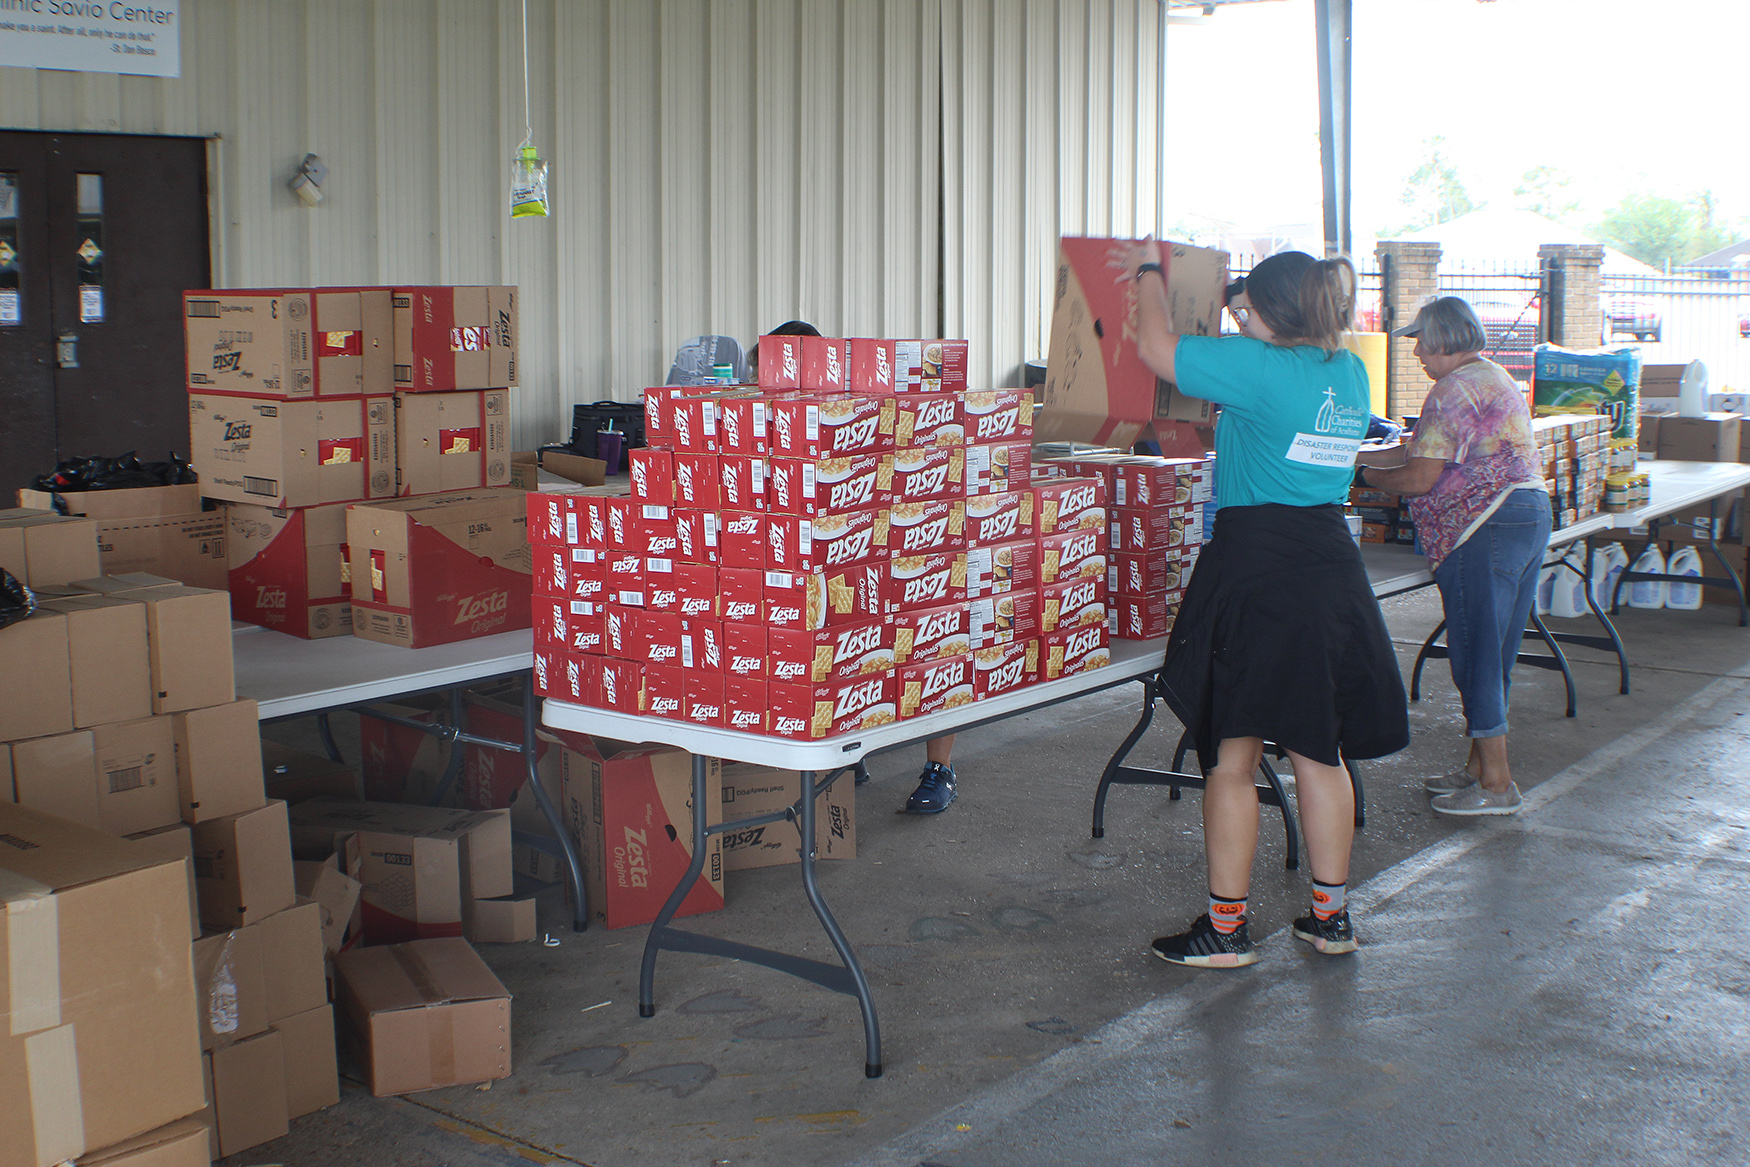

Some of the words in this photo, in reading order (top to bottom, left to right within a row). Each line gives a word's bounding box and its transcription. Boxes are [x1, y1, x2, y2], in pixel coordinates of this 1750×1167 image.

[0, 0, 42, 13] inic
[49, 1, 104, 18] Savio
[109, 1, 175, 24] Center
[422, 294, 433, 323] Zesta
[498, 309, 512, 348] Zesta
[212, 351, 242, 371] Zesta
[422, 357, 433, 386] Zesta
[783, 343, 795, 381] Zesta
[826, 345, 839, 385] Zesta
[876, 346, 889, 385] Zesta
[647, 394, 660, 429] Zesta
[675, 406, 691, 446] Zesta
[724, 406, 739, 447] Zesta
[914, 399, 956, 431] Zesta
[977, 407, 1019, 437] Zesta
[1331, 414, 1363, 428] Charities
[223, 422, 253, 441] Zesta
[777, 408, 791, 450] Zesta
[833, 415, 880, 451] Zesta
[1296, 438, 1332, 450] DISASTER
[1310, 451, 1349, 462] VOLUNTEER
[633, 458, 648, 498] Zesta
[678, 462, 694, 502] Zesta
[724, 463, 738, 504] Zesta
[775, 466, 789, 507] Zesta
[830, 471, 877, 508] Zesta
[904, 464, 949, 497] Zesta
[1137, 473, 1149, 505] Zesta
[1058, 486, 1096, 518] Zesta
[549, 501, 562, 539] Zesta
[589, 504, 603, 542] Zesta
[611, 506, 624, 544] Zesta
[678, 517, 693, 556] Zesta
[727, 519, 759, 534] Zesta
[903, 516, 949, 551] Zesta
[979, 507, 1020, 540] Zesta
[1132, 516, 1144, 549] Zesta
[647, 536, 677, 552] Zesta
[771, 522, 785, 564] Zesta
[826, 527, 873, 565] Zesta
[1059, 534, 1097, 567] Zesta
[553, 553, 566, 591] Zesta
[612, 559, 640, 573] Zesta
[1130, 560, 1142, 592] Zesta
[255, 586, 287, 609] Zesta
[575, 580, 602, 594] Zesta
[859, 578, 867, 611] Original
[866, 566, 880, 615] Zesta
[904, 569, 951, 603] Zesta
[1059, 582, 1096, 616] Zesta
[453, 591, 508, 625] Zesta
[682, 598, 711, 612] Zesta
[726, 602, 756, 617] Zesta
[769, 606, 800, 621] Zesta
[1130, 604, 1142, 636] Zesta
[471, 613, 507, 633] Original
[553, 604, 565, 642] Zesta
[574, 632, 600, 646] Zesta
[609, 612, 622, 651] Zesta
[913, 610, 961, 647] Zesta
[648, 644, 677, 658] Zesta
[704, 628, 719, 668] Zesta
[834, 625, 882, 664] Zesta
[1064, 628, 1101, 662] Zesta
[536, 653, 548, 691] Zesta
[568, 660, 580, 698] Zesta
[730, 656, 761, 670] Zesta
[774, 661, 806, 676] Zesta
[988, 657, 1025, 692] Zesta
[604, 666, 617, 705] Zesta
[921, 662, 965, 700] Zesta
[651, 697, 679, 711] Zesta
[690, 703, 719, 718] Zesta
[834, 680, 883, 720] Zesta
[731, 710, 761, 725] Zesta
[775, 716, 806, 731] Zesta
[769, 785, 784, 794] Shelf
[830, 803, 845, 840] Zesta
[842, 807, 851, 831] Original
[722, 826, 767, 849] Zesta
[386, 855, 411, 865] 00133
[613, 846, 630, 888] Original
[623, 826, 648, 888] Zesta
[712, 854, 720, 880] 00133
